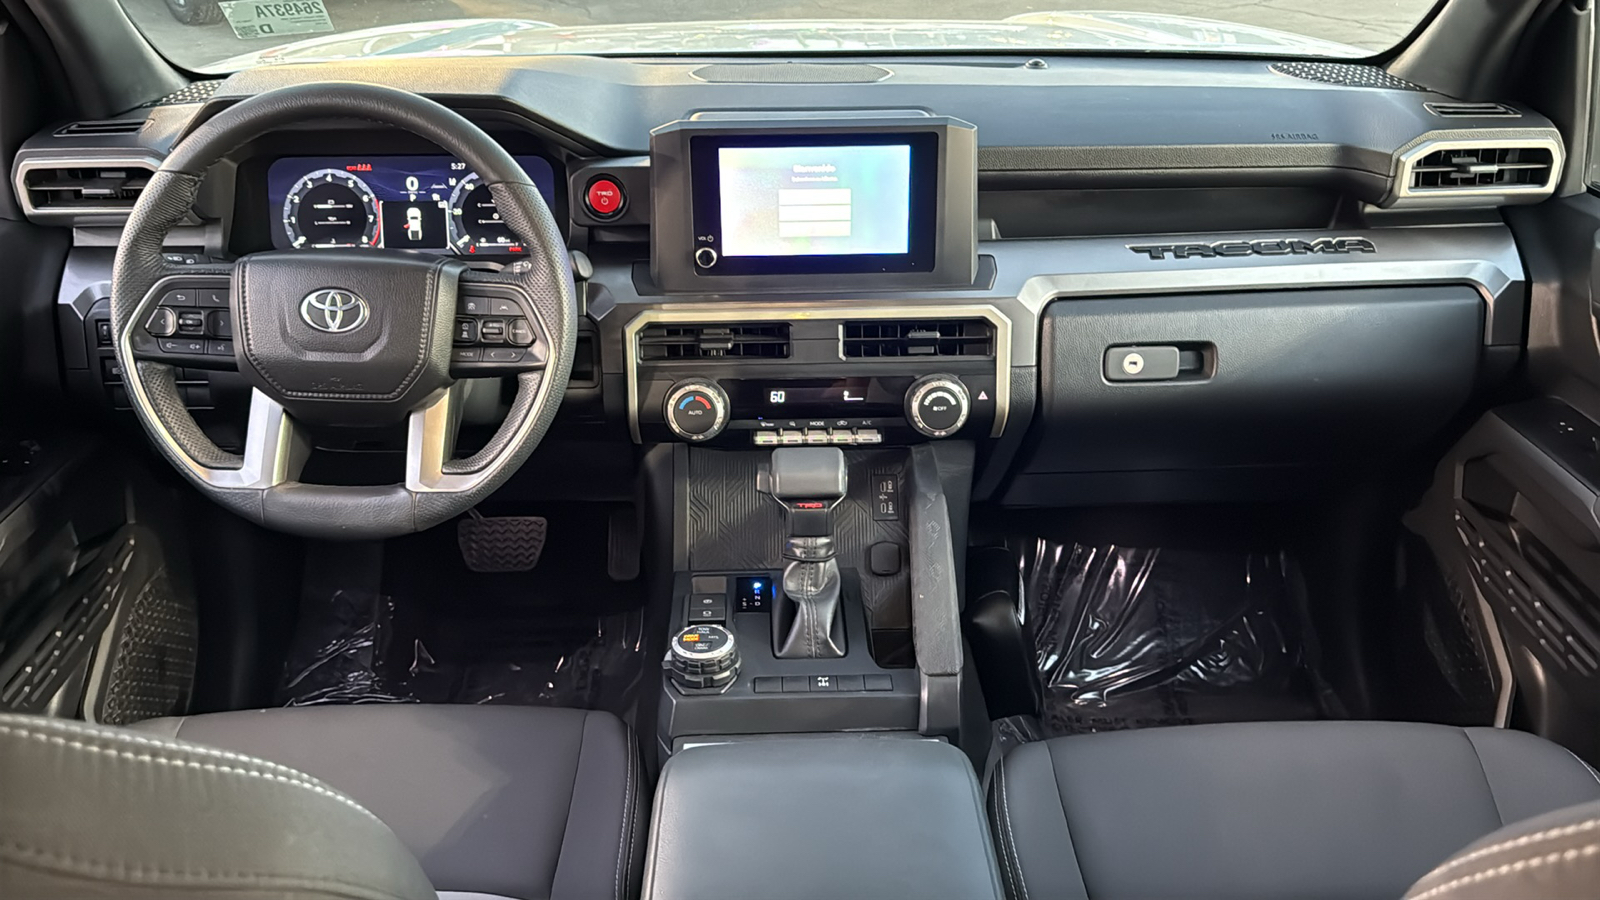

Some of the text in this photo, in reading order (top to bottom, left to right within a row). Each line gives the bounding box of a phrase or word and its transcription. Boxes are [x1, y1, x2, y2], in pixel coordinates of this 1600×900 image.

[406, 175, 419, 191] 0
[1125, 236, 1378, 260] TACOMA
[770, 391, 785, 403] 60
